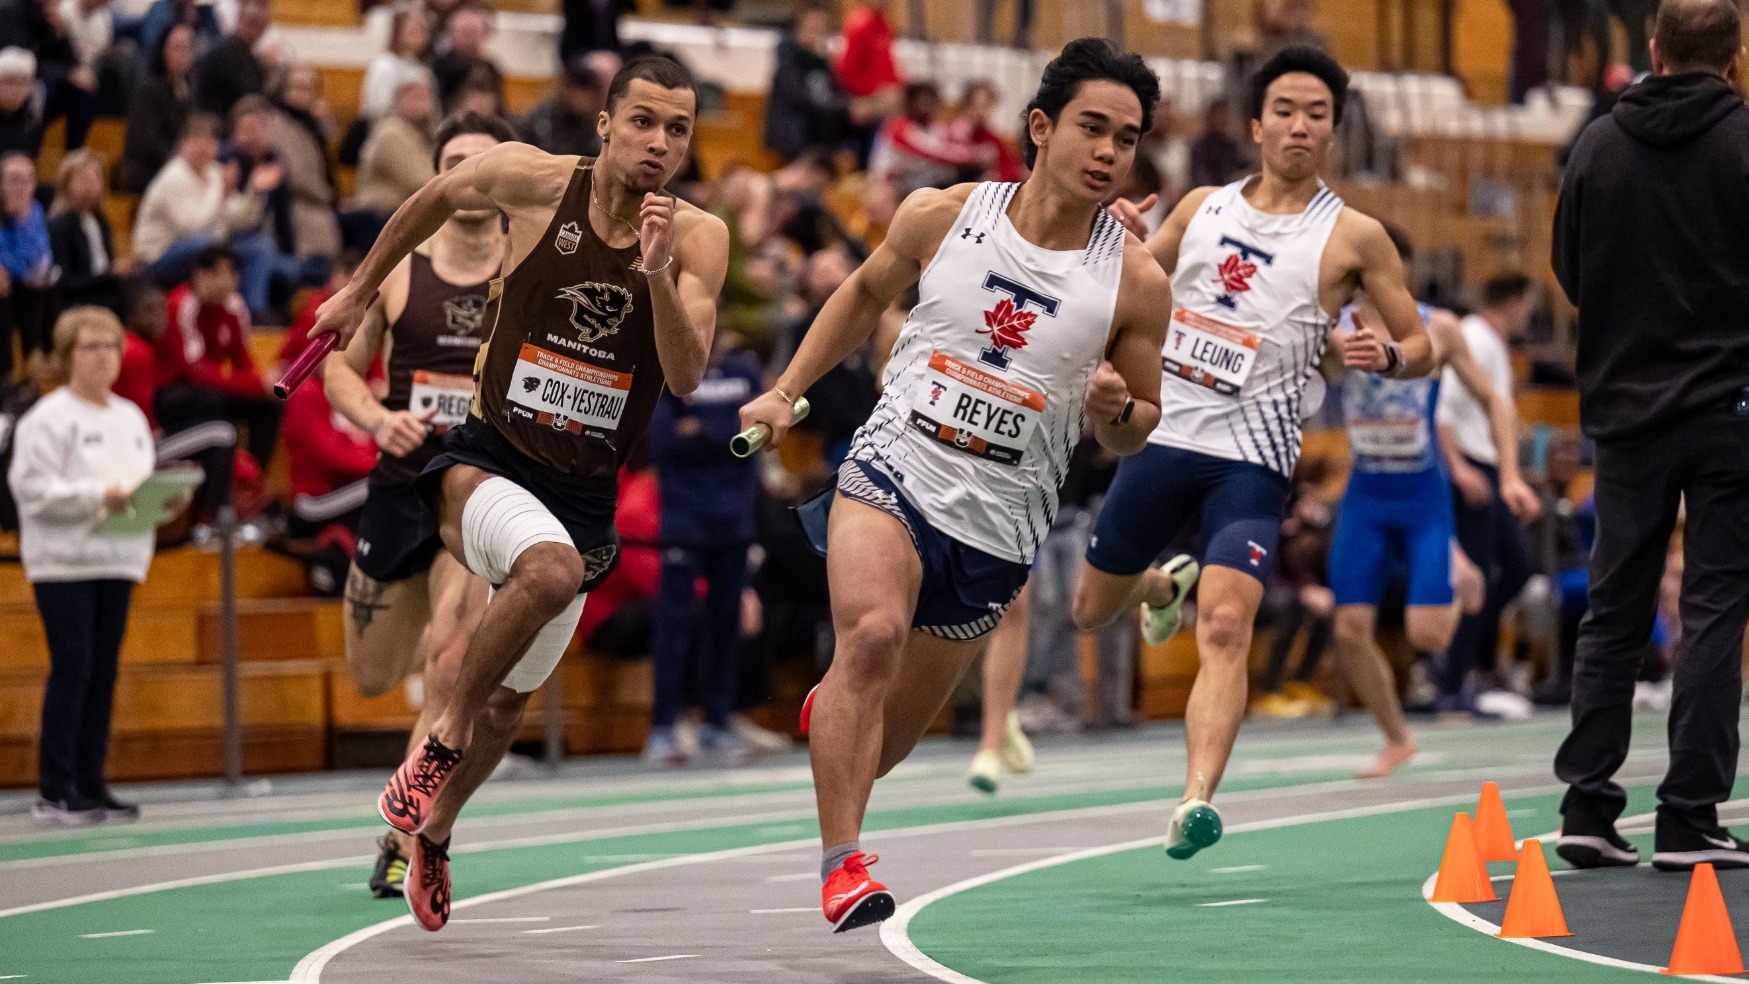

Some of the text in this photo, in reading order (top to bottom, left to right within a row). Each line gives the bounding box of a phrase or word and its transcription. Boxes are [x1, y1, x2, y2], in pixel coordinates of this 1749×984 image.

[558, 237, 576, 251] WEST
[546, 333, 615, 361] MANITOBA
[1190, 337, 1245, 374] LEUNG
[536, 350, 554, 362] TRACK
[559, 358, 575, 369] FIELD
[575, 364, 619, 381] CHAMPIONSHIPS
[966, 369, 984, 381] FIELD
[437, 393, 471, 416] REG
[541, 378, 624, 420] COX-YESTRAU
[952, 392, 1026, 438] REYES
